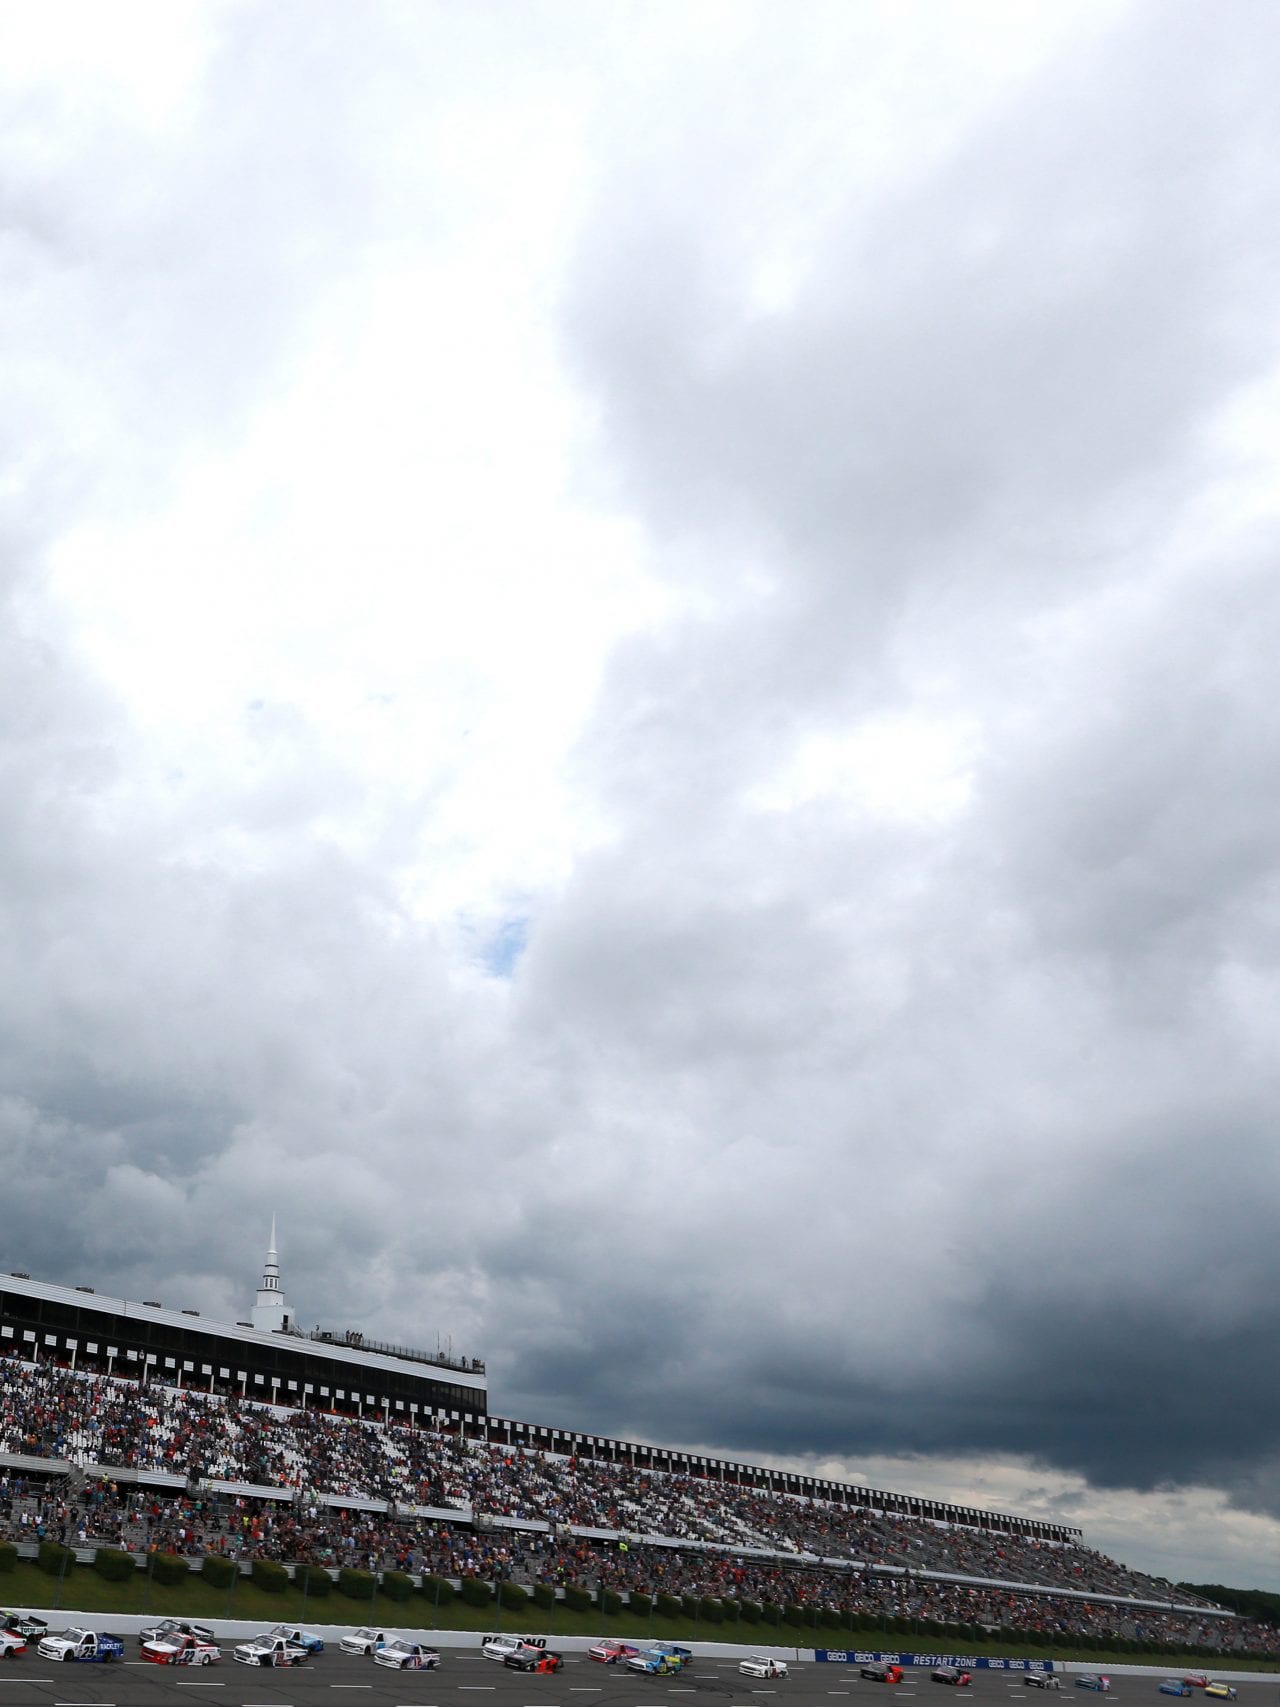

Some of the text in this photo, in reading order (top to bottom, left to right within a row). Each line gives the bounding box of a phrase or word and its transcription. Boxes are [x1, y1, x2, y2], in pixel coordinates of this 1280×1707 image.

[80, 1646, 96, 1658] 25
[827, 1652, 1044, 1670] GEICO GEICO GEICO RESTART ZONE GEICO GEICO GEICO
